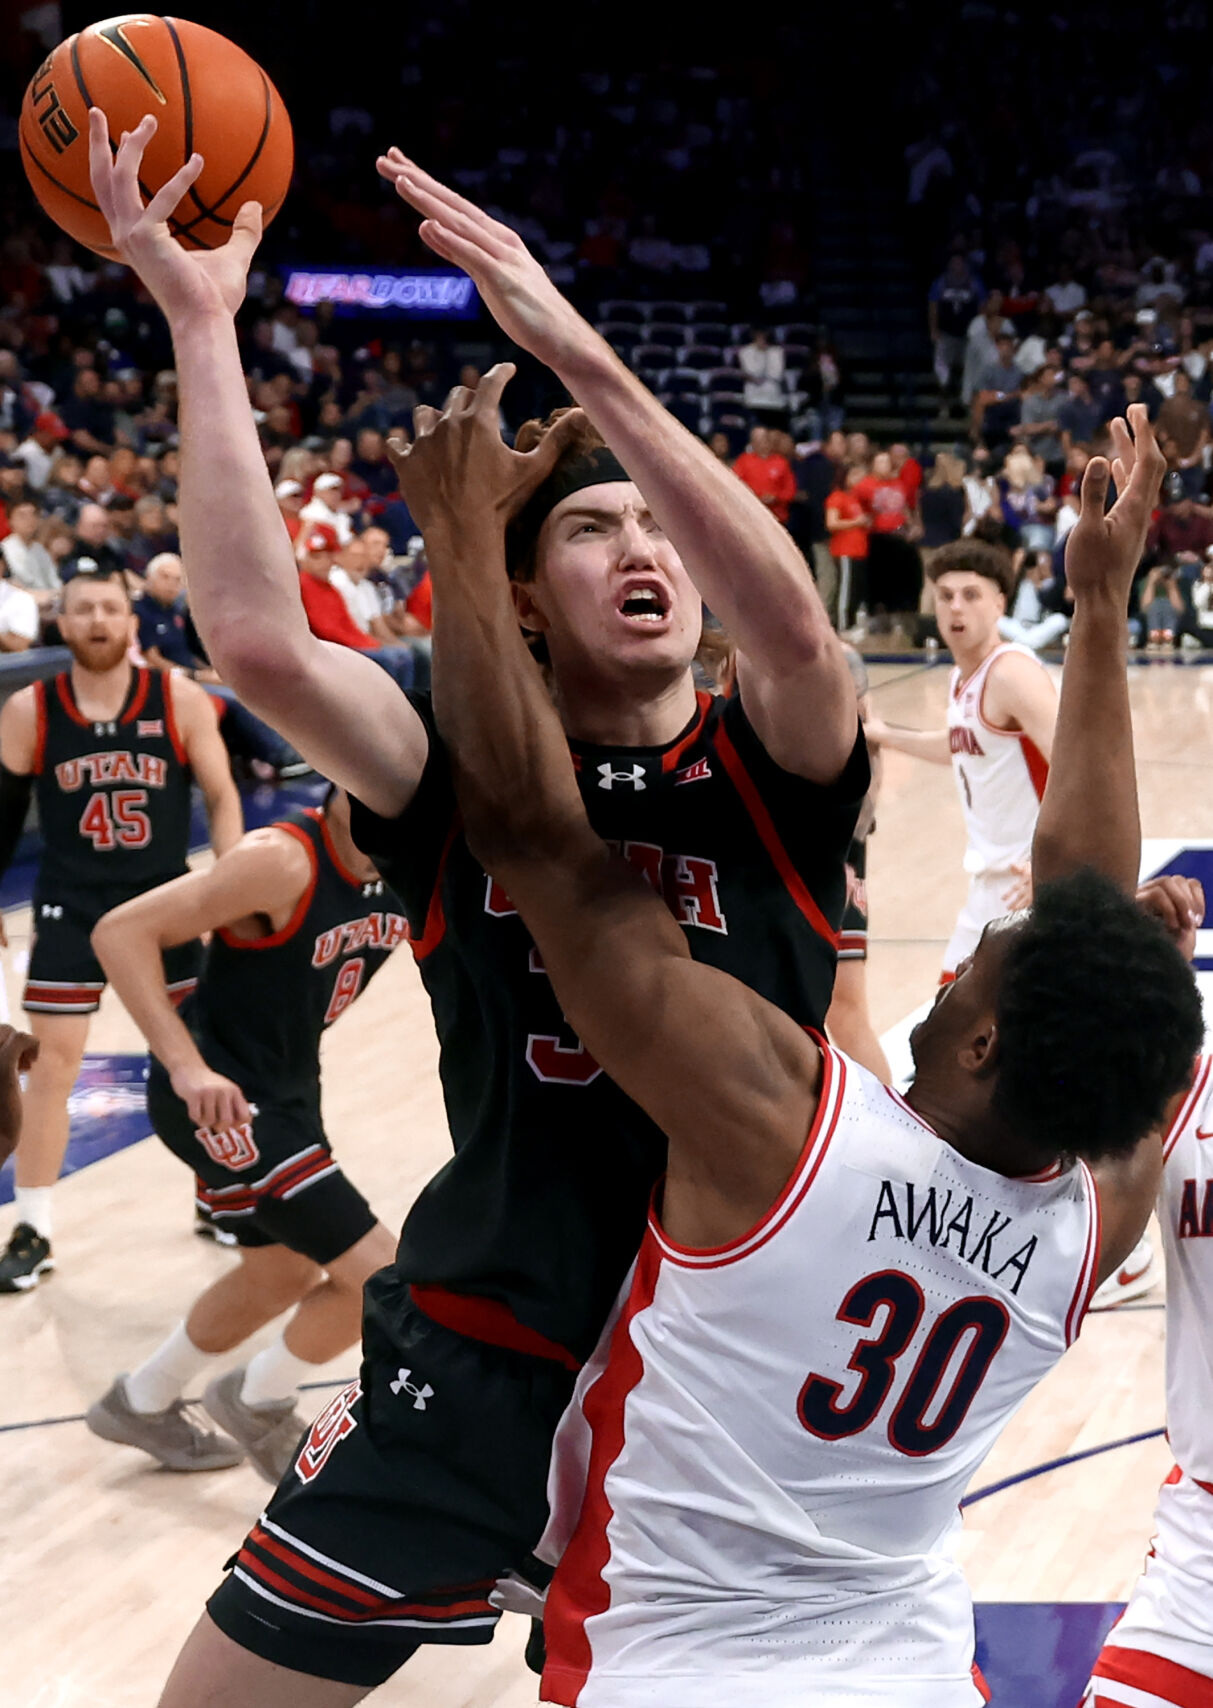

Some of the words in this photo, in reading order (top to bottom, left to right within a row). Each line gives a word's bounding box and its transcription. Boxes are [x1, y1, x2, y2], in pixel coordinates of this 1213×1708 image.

[55, 750, 168, 793] UTAH
[80, 789, 152, 851] 45
[312, 911, 411, 969] UTAH
[323, 957, 366, 1024] 8
[867, 1180, 1039, 1296] AWAKA
[795, 1268, 1011, 1458] 30
